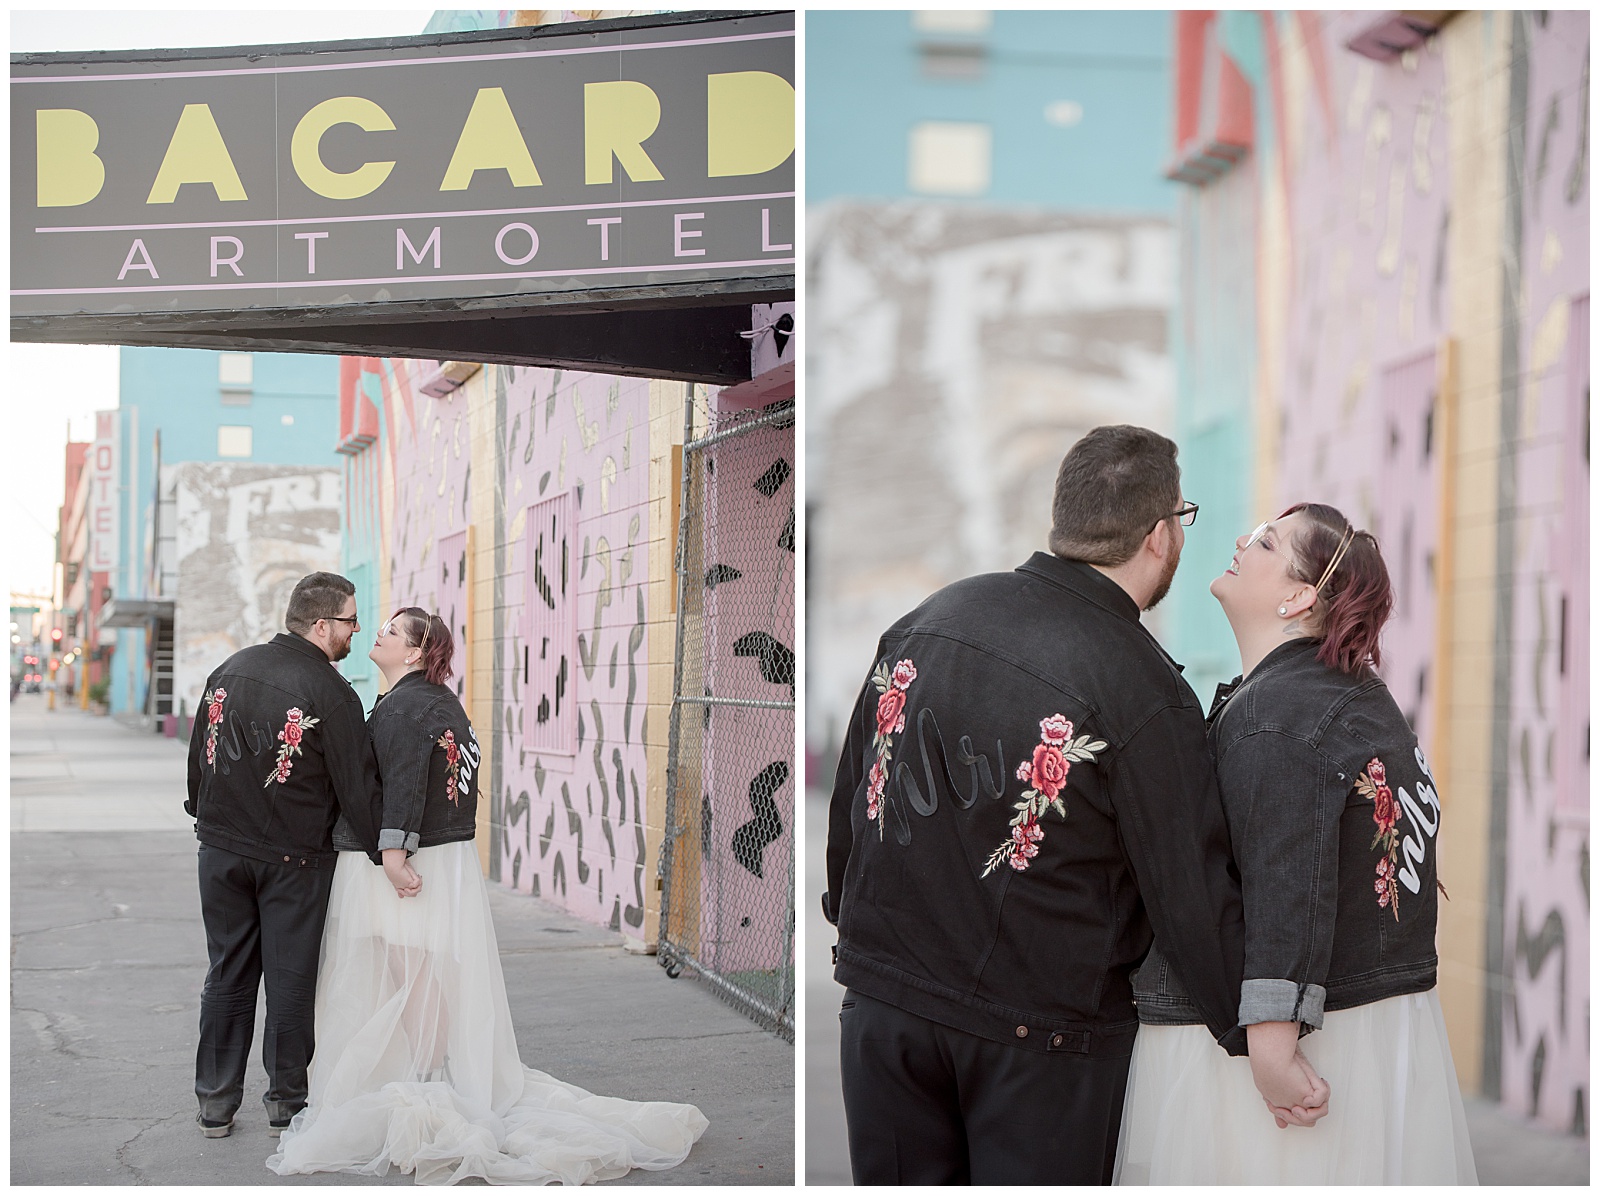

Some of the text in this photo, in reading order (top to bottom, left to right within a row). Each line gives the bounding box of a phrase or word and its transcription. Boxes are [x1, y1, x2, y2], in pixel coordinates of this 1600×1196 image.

[36, 70, 795, 208] BACARD
[116, 208, 793, 281] ART MOTEL
[95, 413, 112, 565] MOTEL
[890, 707, 1006, 847] Mr
